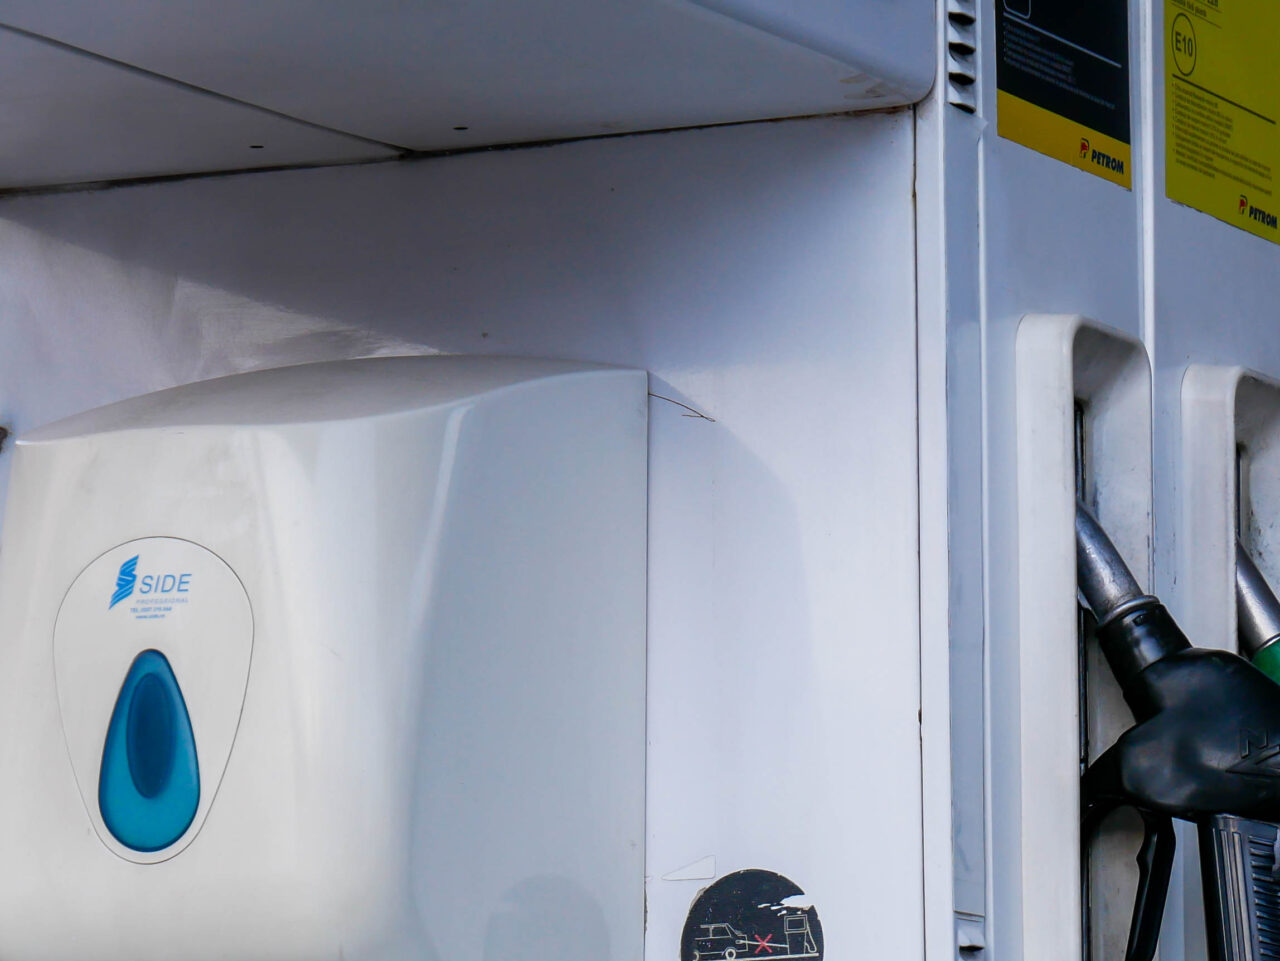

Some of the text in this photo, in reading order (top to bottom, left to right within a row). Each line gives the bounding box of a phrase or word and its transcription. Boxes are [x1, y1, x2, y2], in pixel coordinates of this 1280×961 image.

[1175, 31, 1193, 57] E10
[1091, 149, 1124, 174] PETROM
[1249, 206, 1278, 230] PETROM
[140, 573, 192, 594] SIDE
